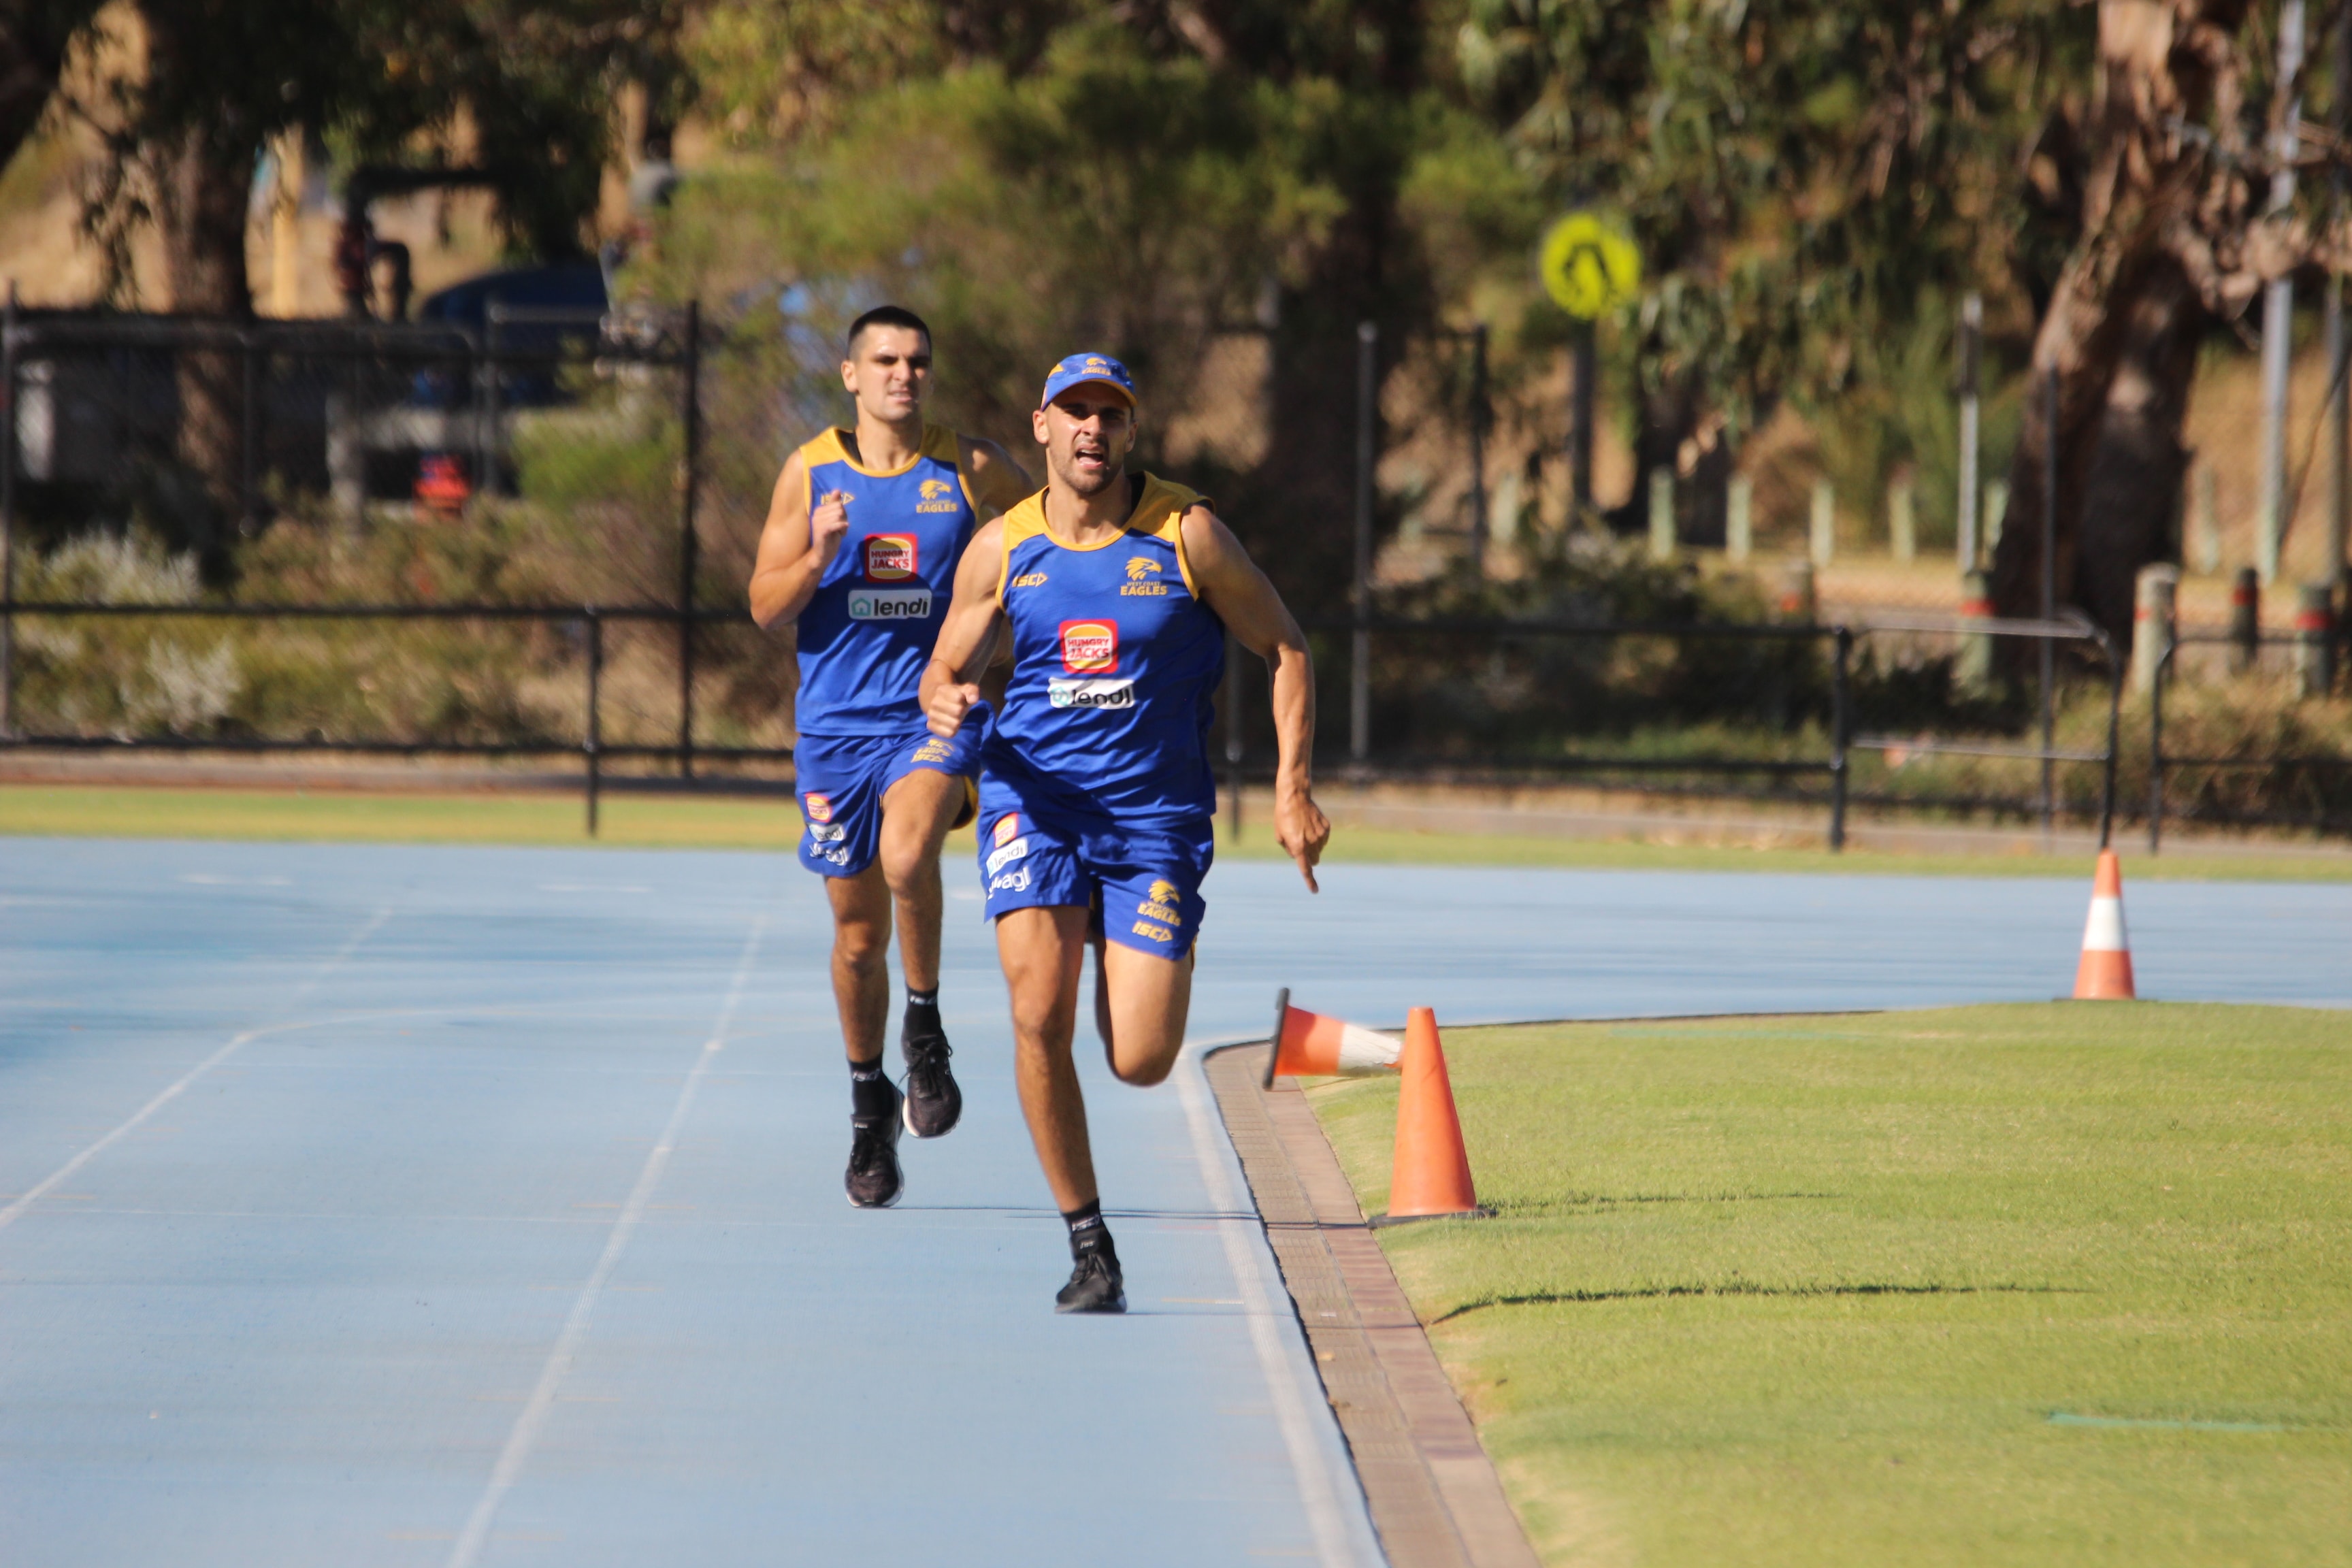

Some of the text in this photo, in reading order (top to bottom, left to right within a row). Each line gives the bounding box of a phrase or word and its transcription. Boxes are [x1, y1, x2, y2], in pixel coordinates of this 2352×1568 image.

[916, 504, 958, 513] EAGLES
[871, 550, 909, 558] HUNGRY
[1011, 573, 1038, 588] ISC
[1120, 586, 1168, 596] EAGLES
[874, 598, 928, 616] lendi
[1068, 638, 1109, 647] HUNGRY
[994, 846, 1024, 868] lendi
[1002, 866, 1031, 892] agl
[1137, 902, 1181, 927] EAGLES
[1132, 921, 1163, 940] ISC
